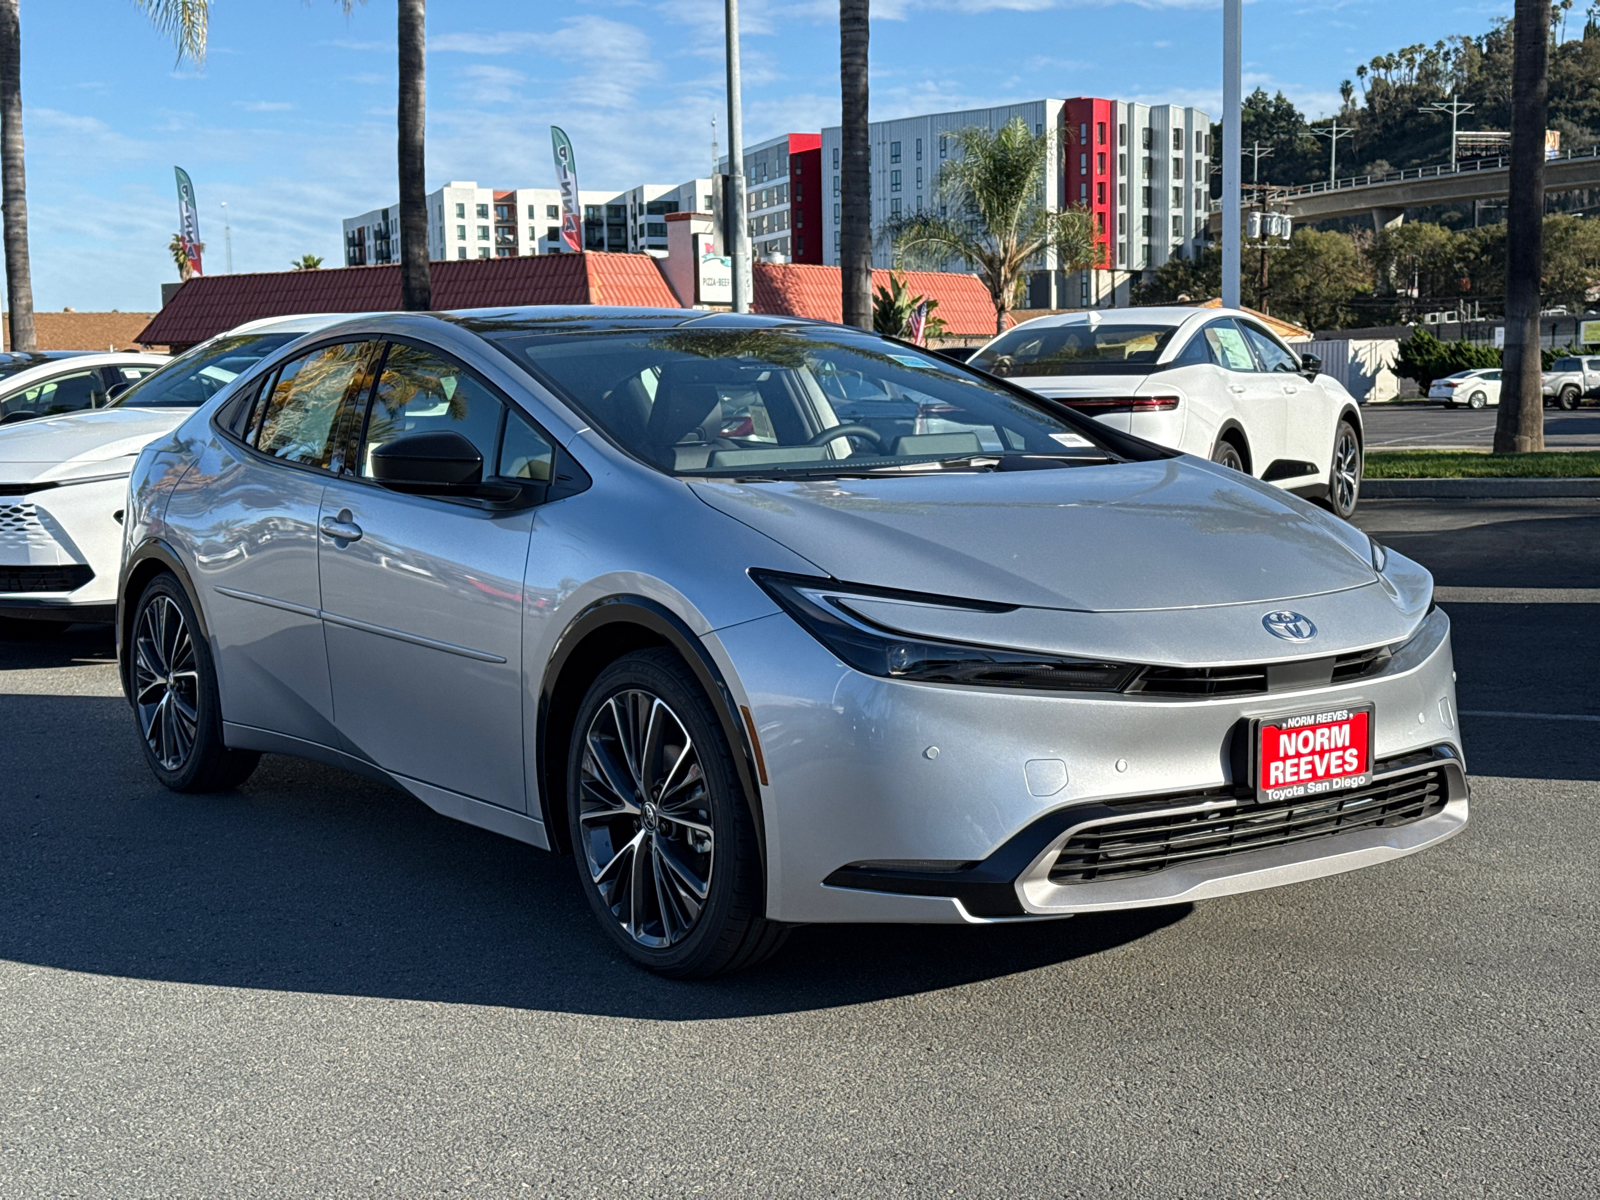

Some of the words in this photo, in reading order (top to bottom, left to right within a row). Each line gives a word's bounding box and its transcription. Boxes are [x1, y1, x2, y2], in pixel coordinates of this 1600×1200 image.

[1287, 715, 1315, 728] NORM
[1316, 710, 1348, 724] REEVES
[1279, 724, 1350, 757] NORM
[1269, 748, 1358, 785] REEVES
[1266, 785, 1305, 801] Toyota
[1306, 780, 1330, 793] San
[1332, 776, 1366, 789] Diego
